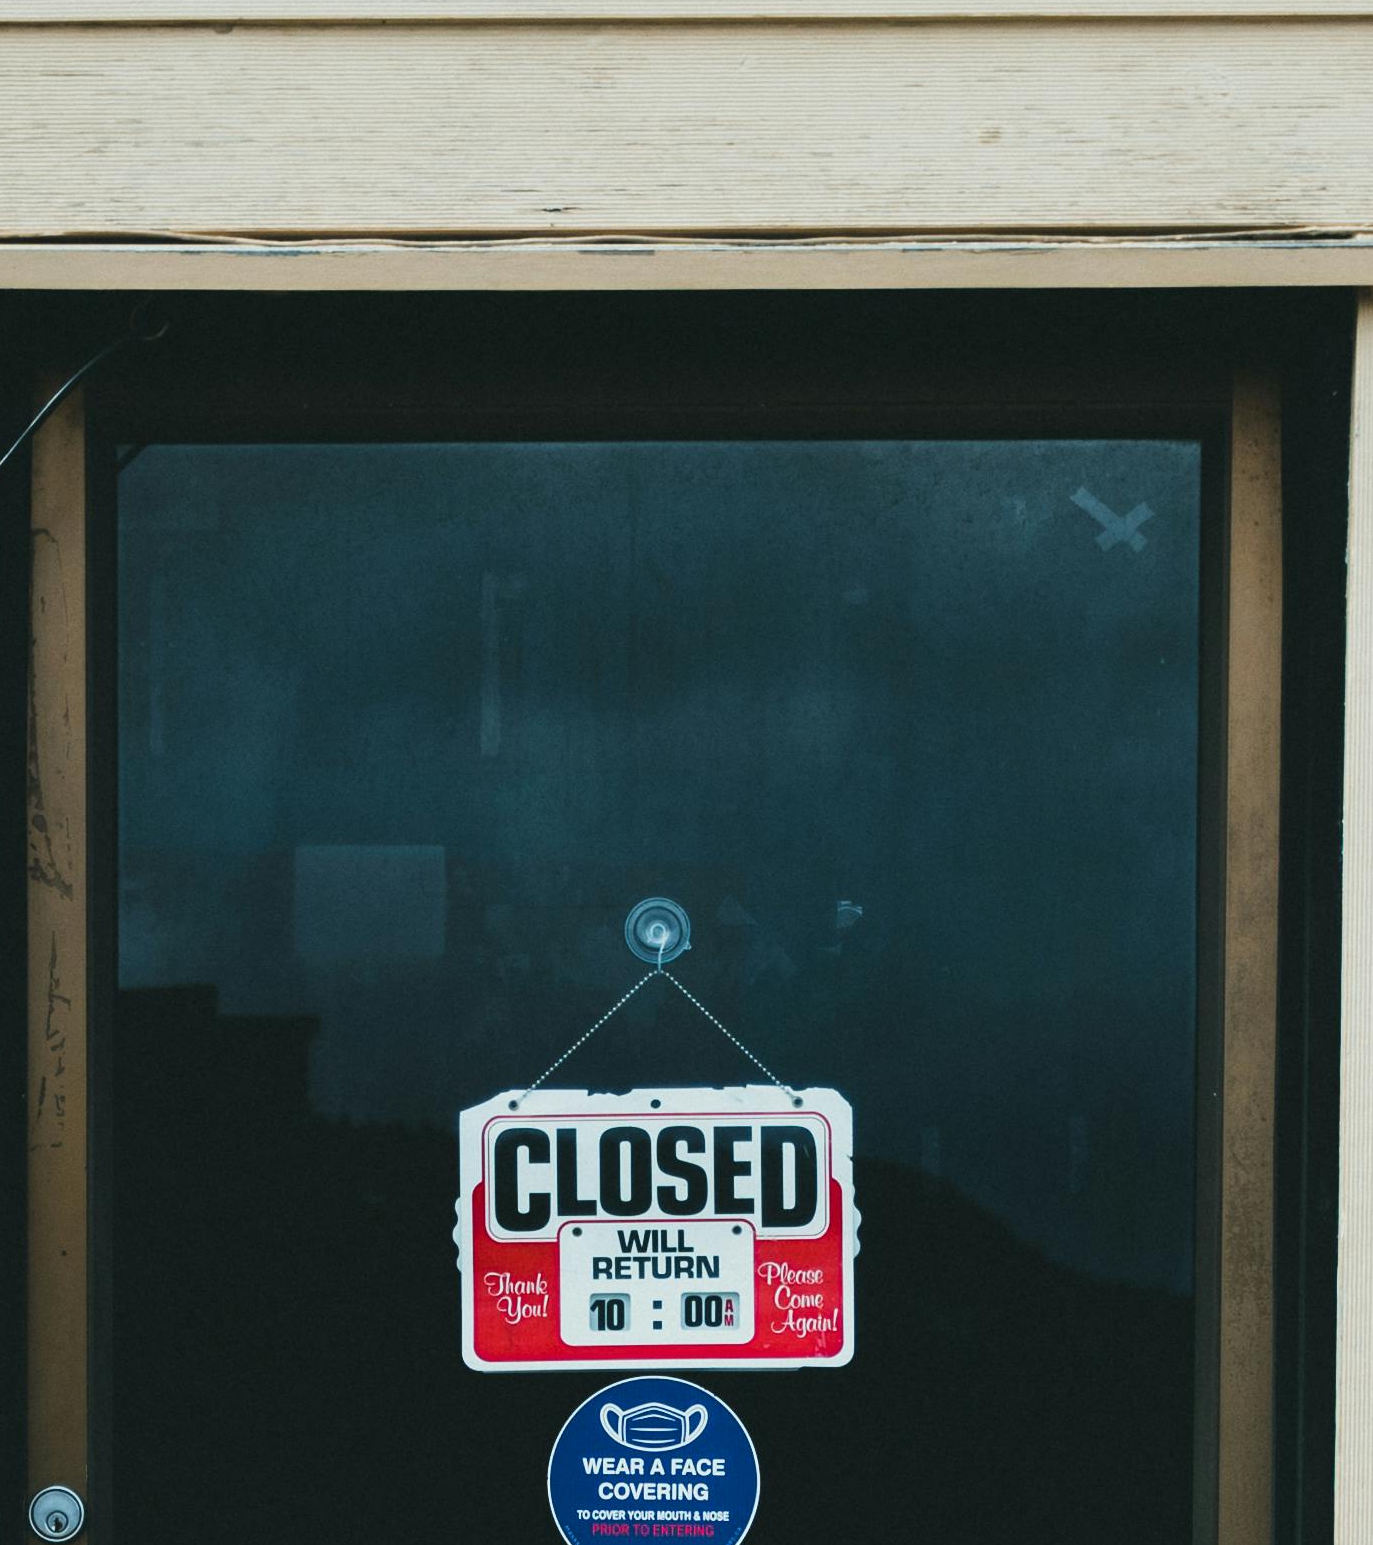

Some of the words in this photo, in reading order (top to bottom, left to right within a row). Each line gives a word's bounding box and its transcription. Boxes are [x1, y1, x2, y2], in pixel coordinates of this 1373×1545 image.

[494, 1125, 818, 1232] CLOSED
[617, 1229, 694, 1253] WILL
[592, 1255, 720, 1280] RETURN
[757, 1261, 824, 1286] Please
[483, 1271, 548, 1297] Thank
[496, 1294, 549, 1325] You!
[774, 1284, 824, 1310] Come
[590, 1298, 625, 1331] 10
[684, 1295, 722, 1328] 00
[770, 1307, 839, 1339] Again!
[582, 1457, 644, 1476] WEAR
[650, 1458, 665, 1476] A
[671, 1458, 726, 1476] FACE
[598, 1482, 709, 1501] COVERING
[577, 1510, 590, 1520] TO
[592, 1510, 626, 1521] COVER
[628, 1510, 655, 1521] YOUR
[657, 1511, 692, 1521] MOUTH
[693, 1511, 701, 1521] &
[703, 1511, 730, 1522] NOSE
[592, 1523, 630, 1536] PRIOR
[633, 1523, 650, 1536] TO
[652, 1523, 715, 1537] ENTERING
